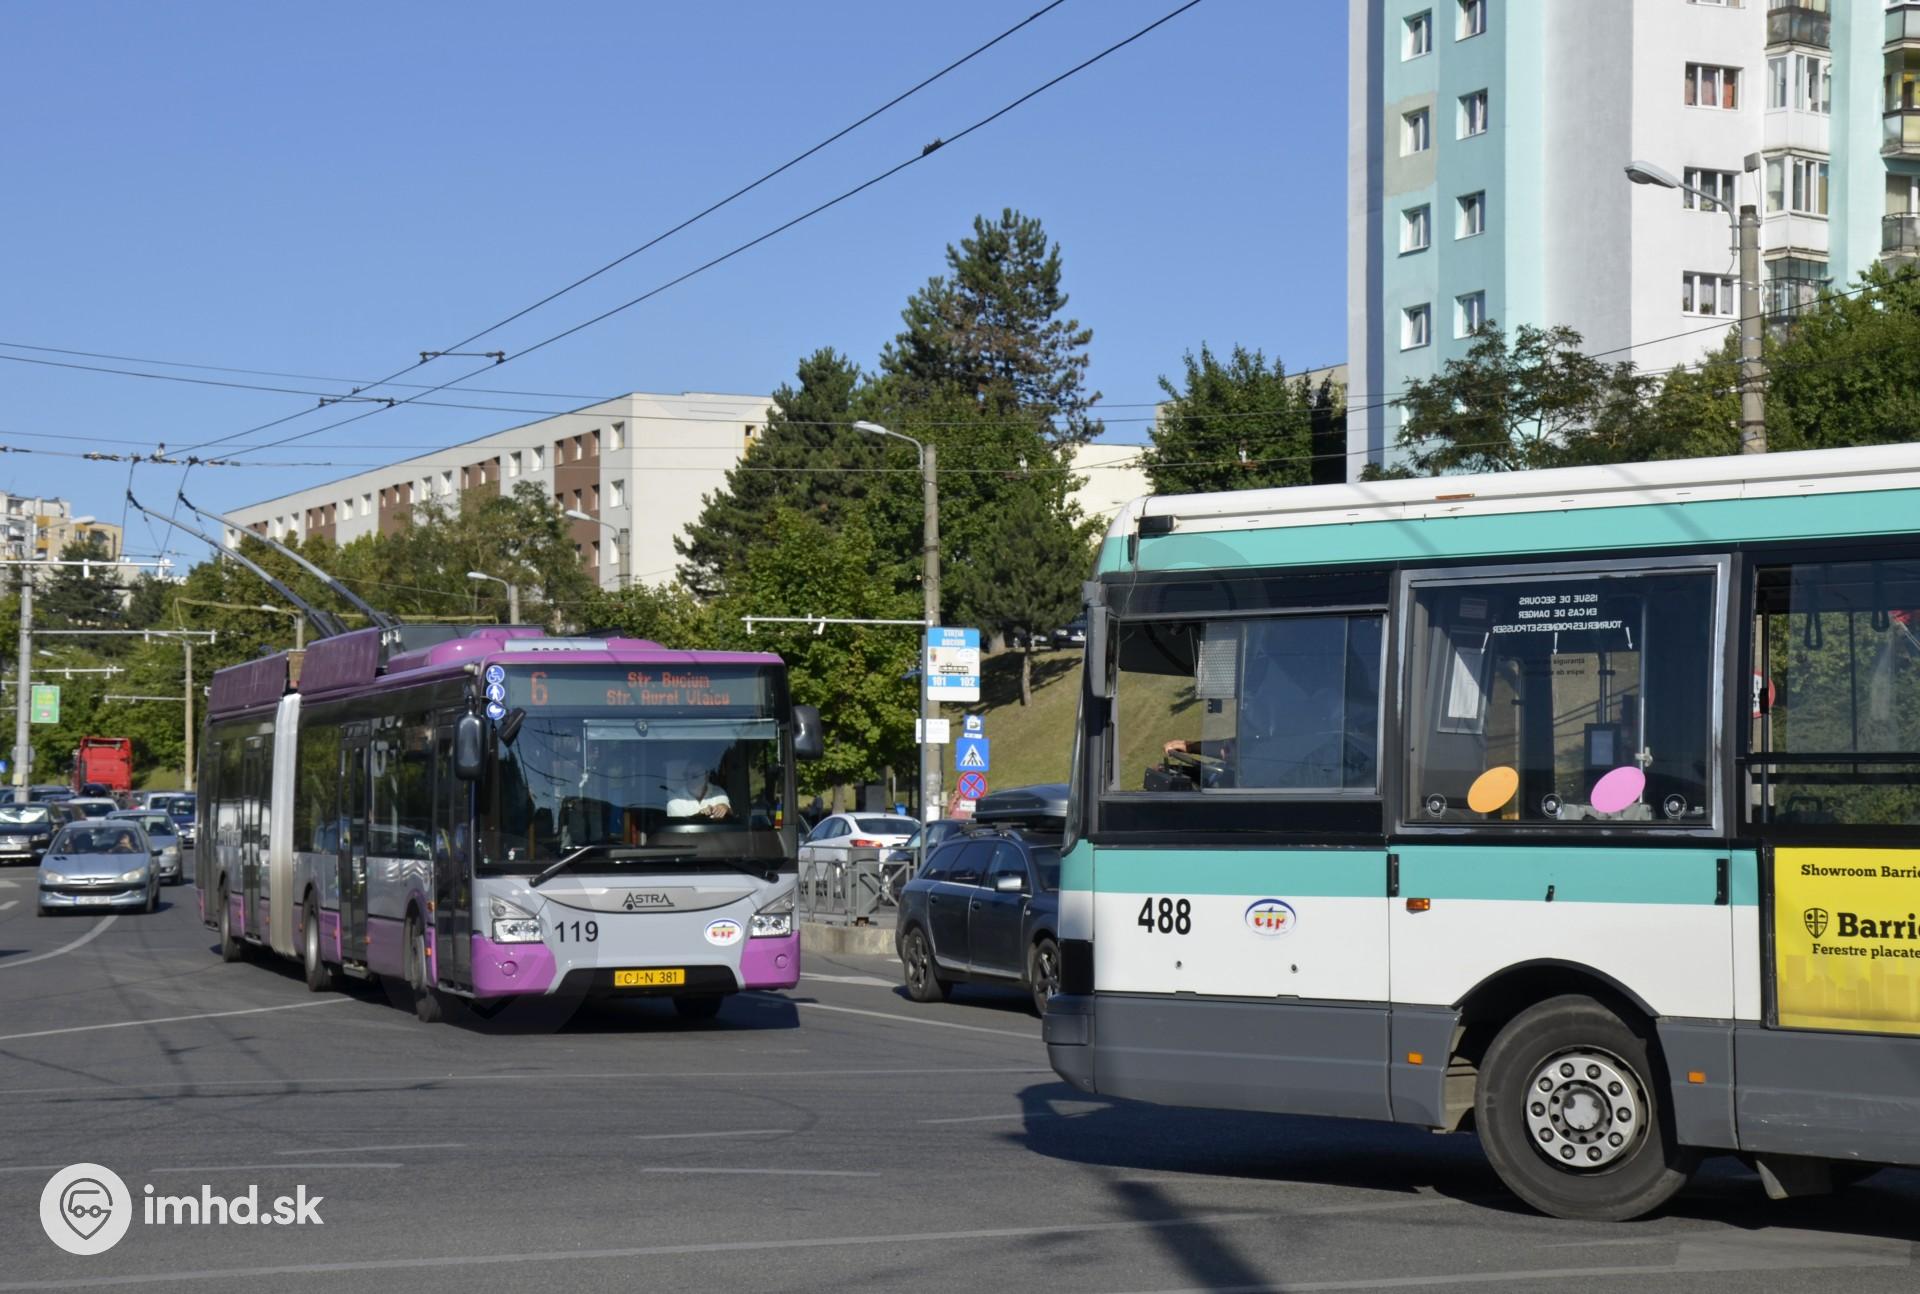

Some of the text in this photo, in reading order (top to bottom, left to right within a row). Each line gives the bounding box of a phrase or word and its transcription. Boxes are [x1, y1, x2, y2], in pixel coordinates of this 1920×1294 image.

[529, 671, 549, 706] 6
[627, 671, 710, 689] Str. Bucium
[607, 689, 635, 706] Str.
[1801, 864, 1920, 879] Showroom Barri
[622, 892, 675, 910] ASTRA
[1138, 897, 1191, 935] 488
[554, 920, 599, 943] 119
[1837, 912, 1920, 939] Barri
[1812, 943, 1867, 957] Ferestre
[624, 971, 677, 984] CJ-N 381
